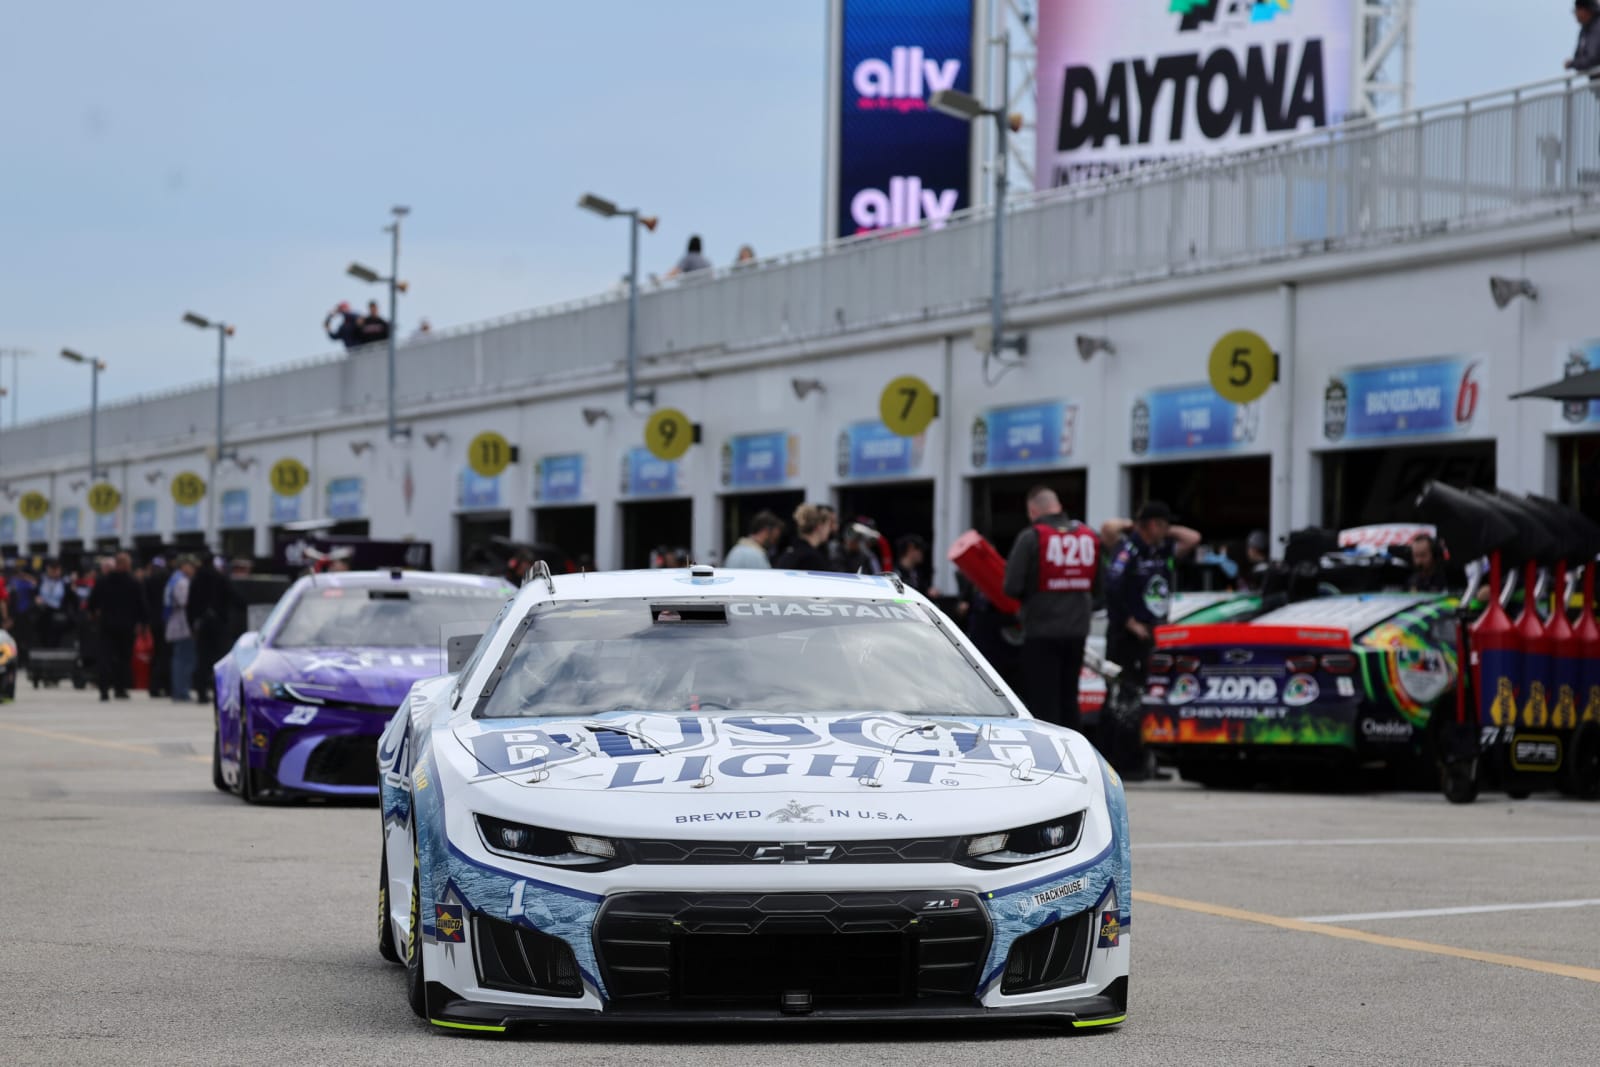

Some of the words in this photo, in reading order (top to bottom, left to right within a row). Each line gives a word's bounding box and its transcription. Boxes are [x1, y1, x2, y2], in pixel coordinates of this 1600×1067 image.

[853, 46, 961, 98] ally
[1057, 38, 1327, 152] DAYTONA
[850, 175, 959, 230] ally
[1228, 348, 1252, 387] 5
[898, 388, 918, 420] 7
[1455, 359, 1480, 423] 6
[658, 418, 678, 448] 9
[481, 440, 500, 465] 11
[1046, 534, 1096, 566] 420
[731, 602, 917, 619] CHASTAIN
[1204, 675, 1278, 701] zone
[1179, 705, 1289, 719] CHEVROLET
[470, 714, 1087, 784] BUSCH
[605, 752, 957, 789] LIGHT
[675, 810, 762, 824] BREWED
[829, 809, 850, 818] IN
[858, 811, 913, 821] U.S.A.
[506, 880, 528, 918] 1
[923, 898, 960, 909] ZL1
[1034, 880, 1083, 906] TRACKHOUSE
